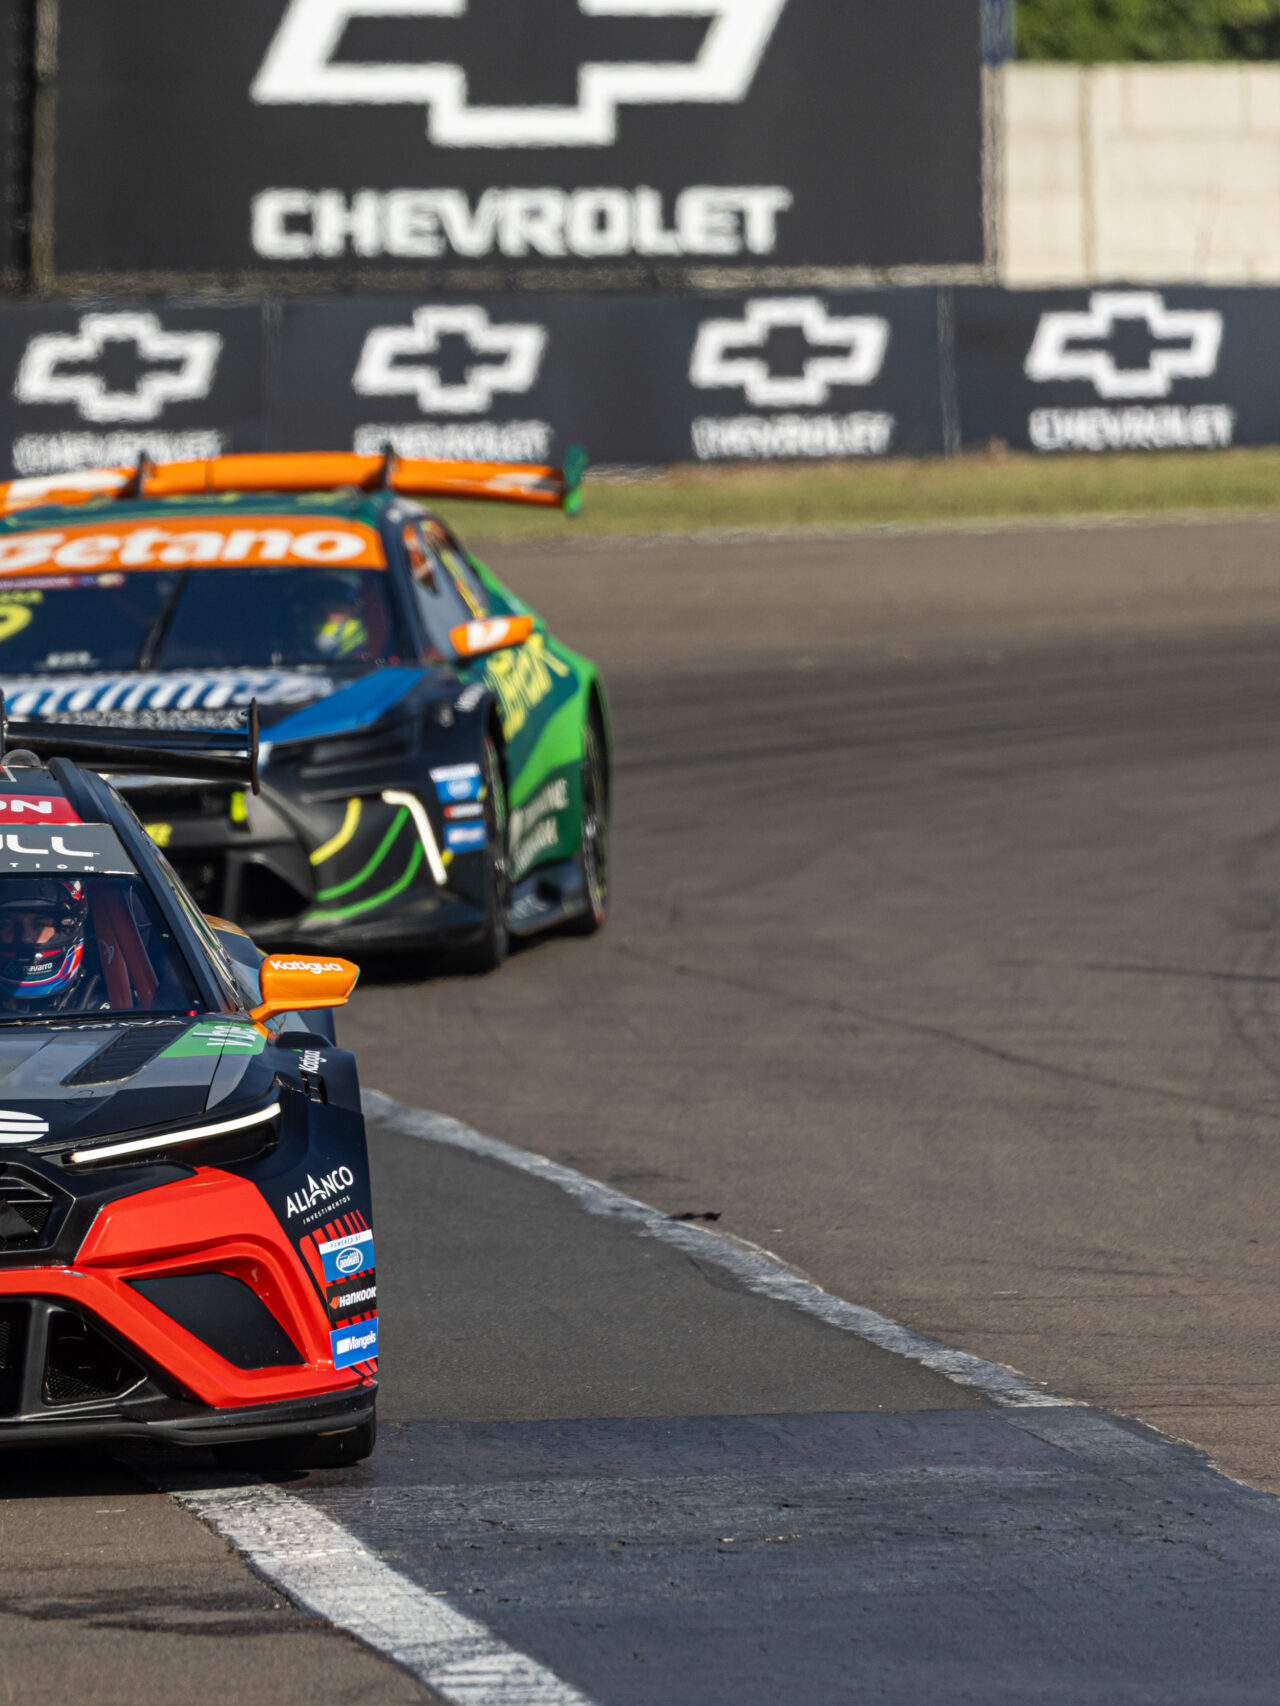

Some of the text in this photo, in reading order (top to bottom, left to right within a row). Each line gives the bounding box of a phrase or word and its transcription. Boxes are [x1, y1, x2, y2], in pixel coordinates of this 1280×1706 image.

[252, 186, 793, 259] CHEVROLET
[1029, 405, 1234, 450] CHEVROLET
[286, 1165, 355, 1219] ALIANCO
[302, 1195, 351, 1225] INVESTIMENTOS
[330, 1236, 355, 1249] POWERED
[339, 1255, 360, 1269] podium
